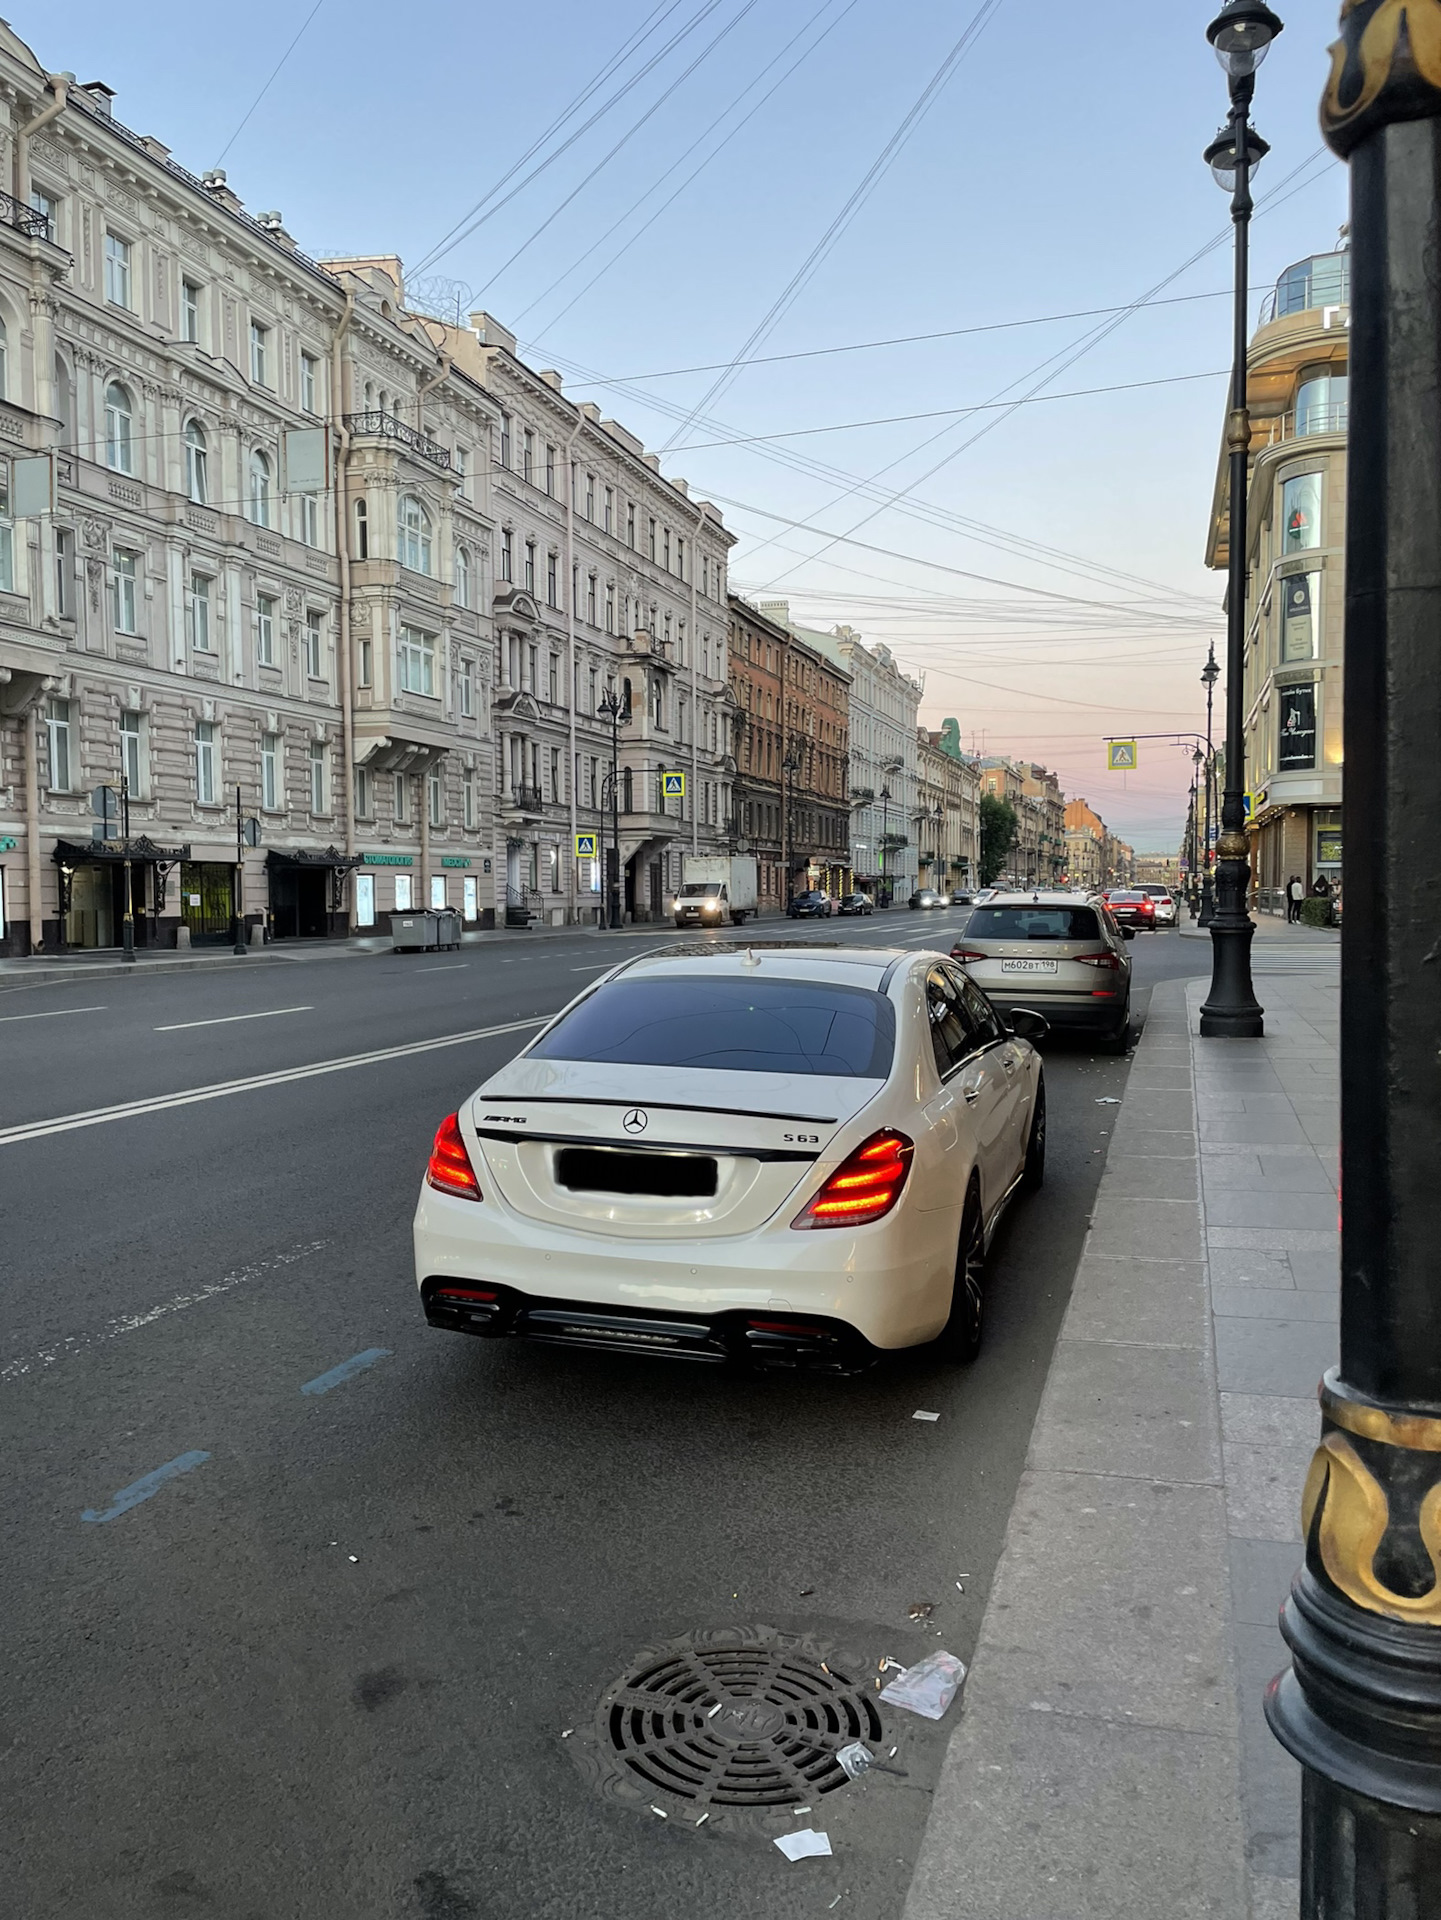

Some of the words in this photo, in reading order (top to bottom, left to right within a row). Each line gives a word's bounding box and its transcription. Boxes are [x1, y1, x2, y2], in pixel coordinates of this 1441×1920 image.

[483, 1115, 527, 1123] AMG
[783, 1133, 794, 1142] S
[797, 1134, 819, 1143] 63
